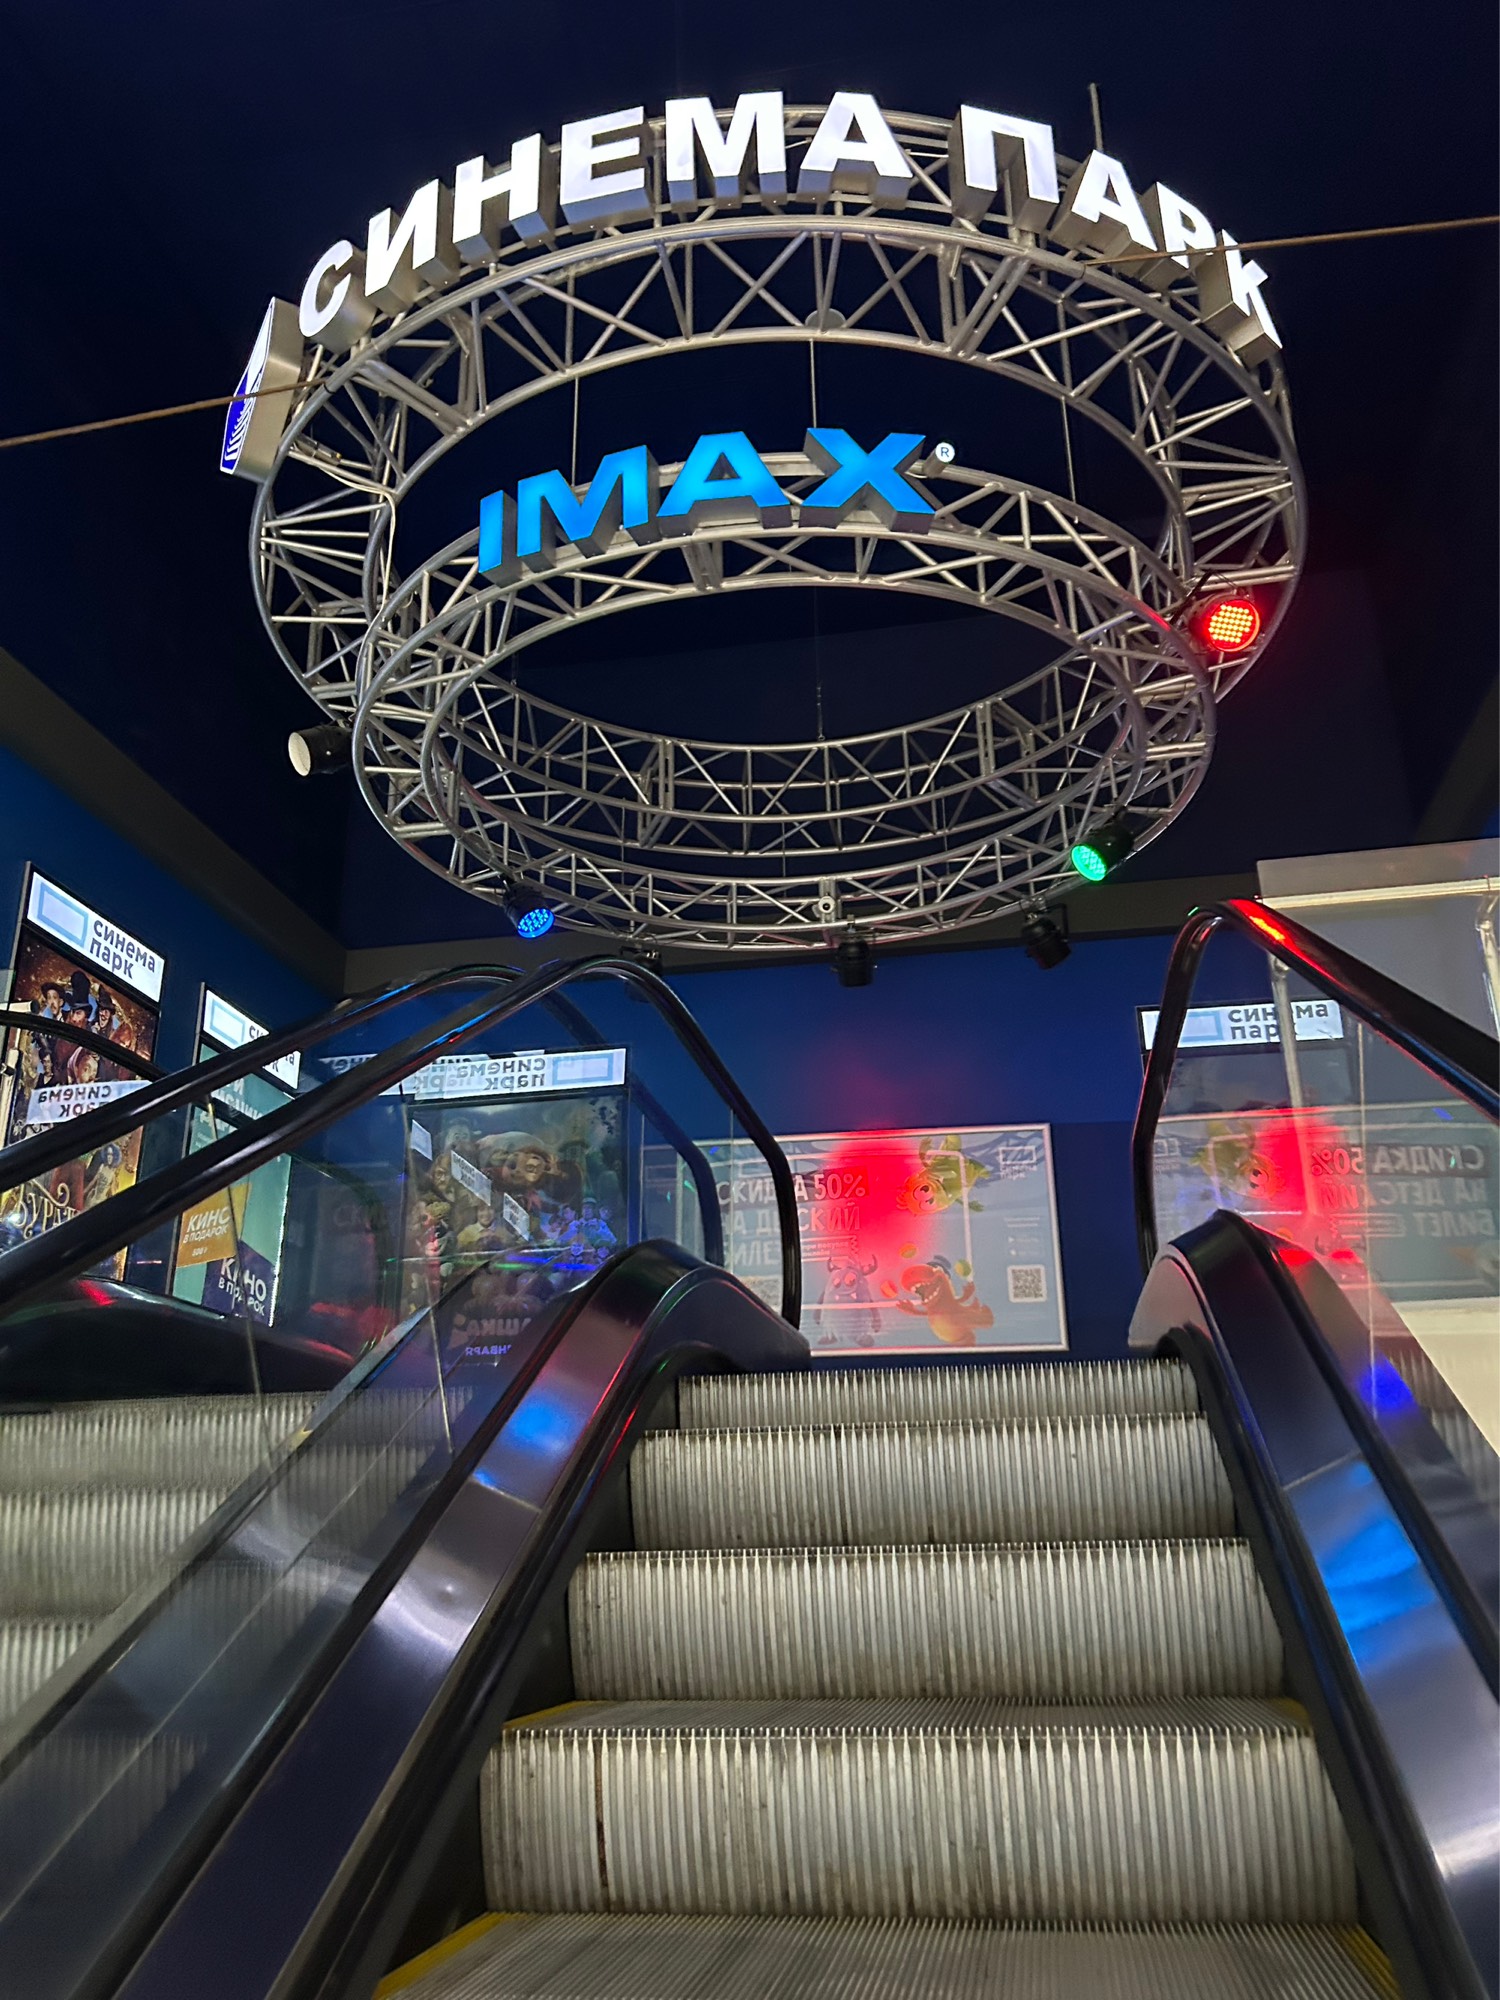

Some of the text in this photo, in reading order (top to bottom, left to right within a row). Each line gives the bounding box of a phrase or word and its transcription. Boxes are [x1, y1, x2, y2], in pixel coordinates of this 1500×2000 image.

[299, 91, 1283, 349] СИНЕМА ПАРК
[478, 428, 935, 573] IMAX
[89, 938, 133, 980] парк
[93, 920, 156, 973] синема
[1228, 1003, 1329, 1024] синма
[1230, 1023, 1296, 1043] пар
[814, 1172, 866, 1201] 50%
